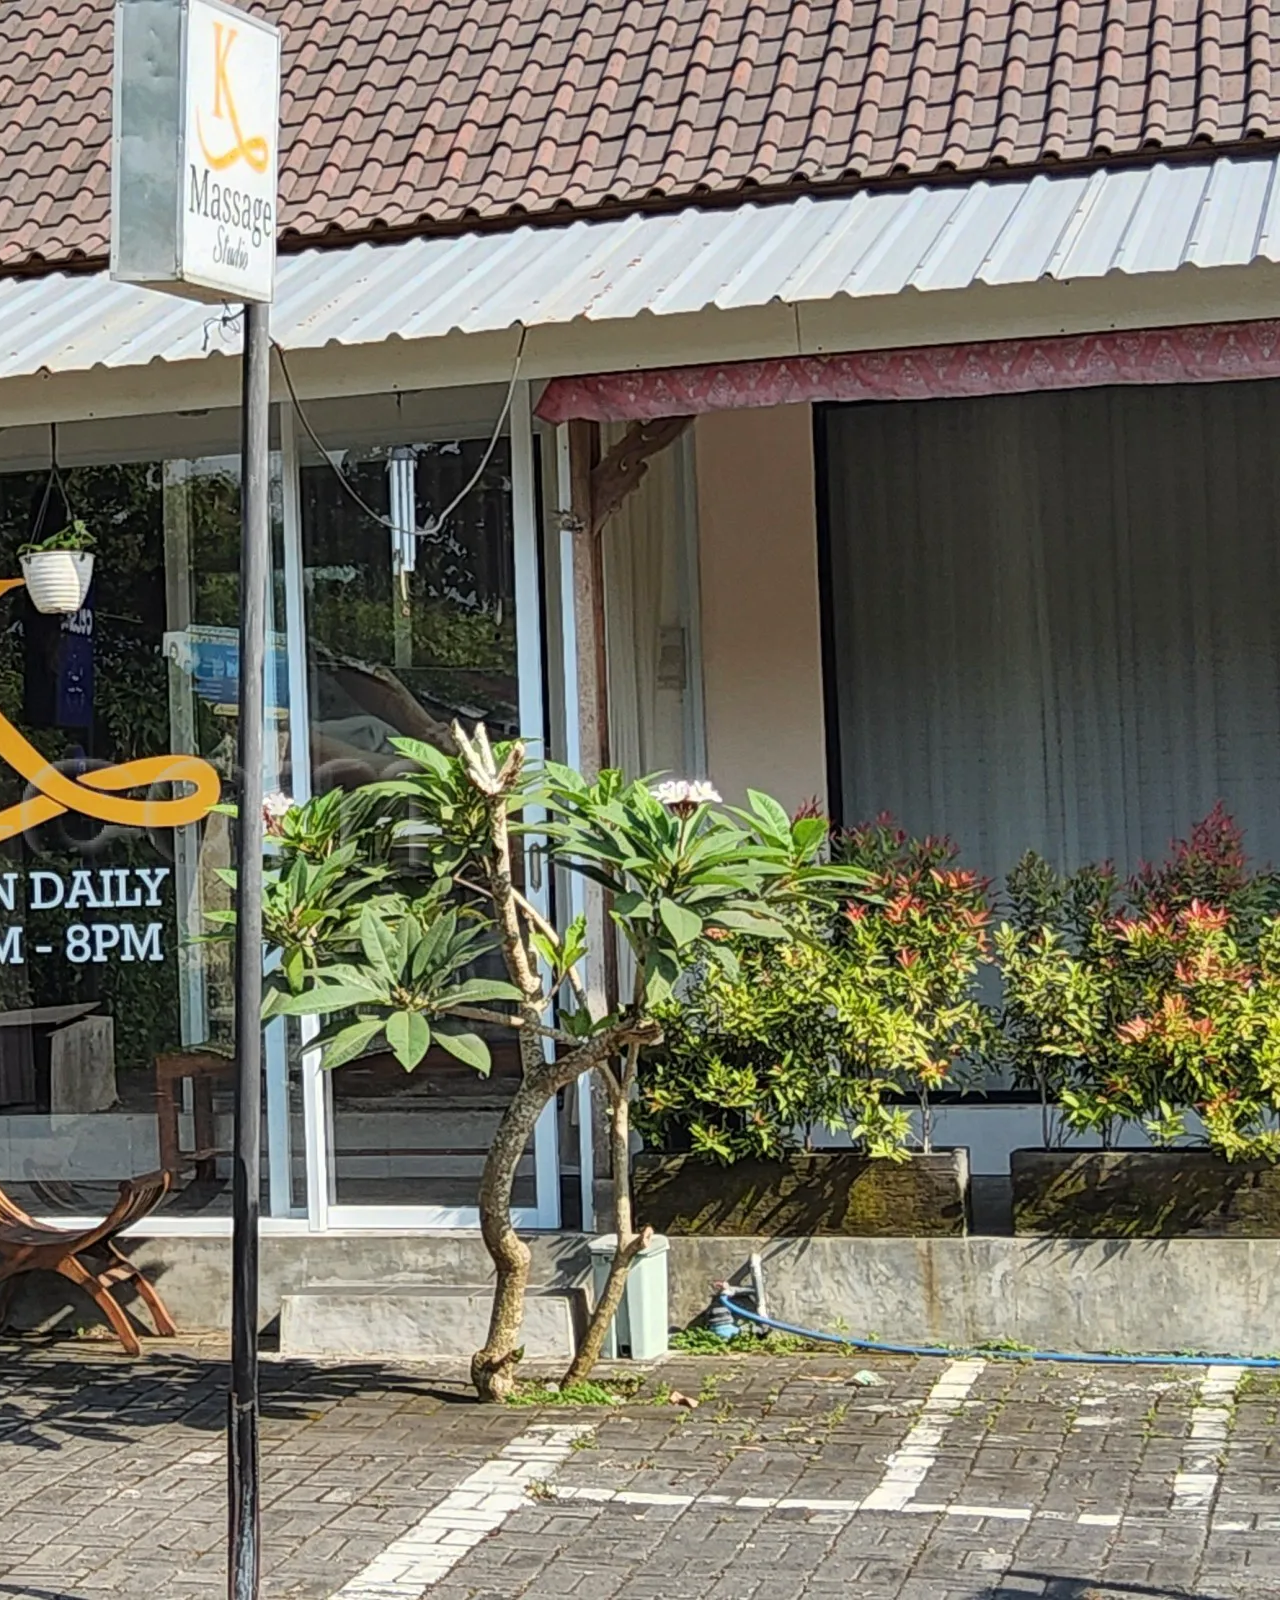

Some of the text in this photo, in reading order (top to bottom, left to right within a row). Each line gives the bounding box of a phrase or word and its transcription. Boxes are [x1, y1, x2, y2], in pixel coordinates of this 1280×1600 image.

[189, 163, 272, 248] Massage
[212, 224, 249, 271] Studio
[29, 867, 170, 911] DAILY
[66, 922, 164, 963] 8PM
